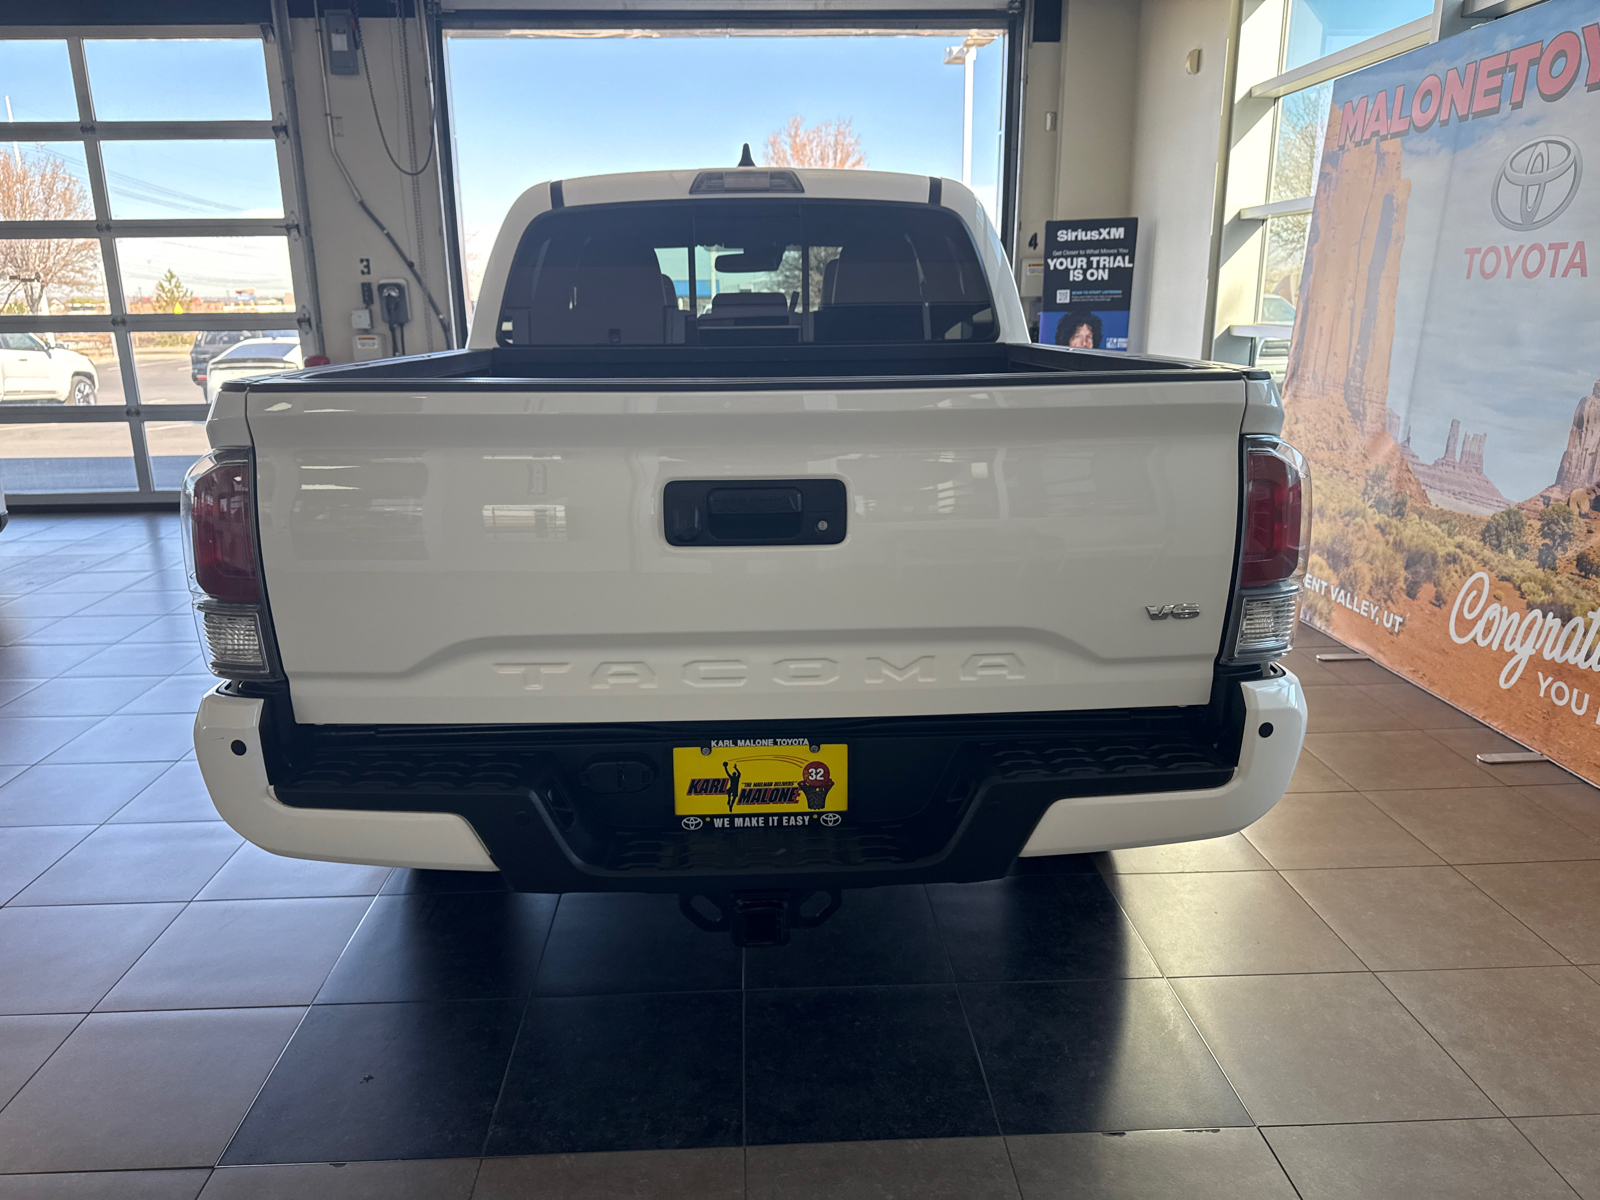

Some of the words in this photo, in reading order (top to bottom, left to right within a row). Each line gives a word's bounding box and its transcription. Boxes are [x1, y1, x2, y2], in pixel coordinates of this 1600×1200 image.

[1028, 232, 1038, 251] 4
[1057, 227, 1125, 242] SiriusXM
[359, 258, 371, 276] 3
[1047, 257, 1087, 270] YOUR
[1090, 255, 1133, 269] TRIAL
[1464, 241, 1588, 280] TOYOTA
[1069, 269, 1083, 281] IS
[1086, 268, 1109, 281] ON
[1145, 603, 1200, 621] V6
[1303, 573, 1328, 596] ENT
[1330, 584, 1380, 626] VALLEY,
[1382, 610, 1403, 633] UT
[493, 652, 1026, 691] TACOMA
[1537, 671, 1590, 716] YOU
[711, 739, 735, 748] KARL
[737, 738, 774, 747] MALONE
[776, 738, 809, 746] TOYOTA
[808, 768, 824, 780] 32
[687, 778, 729, 796] KARL
[737, 786, 800, 806] MALONE
[714, 817, 730, 828] WE
[735, 816, 764, 828] MAKE
[769, 816, 778, 826] IT
[783, 815, 810, 826] EASY
